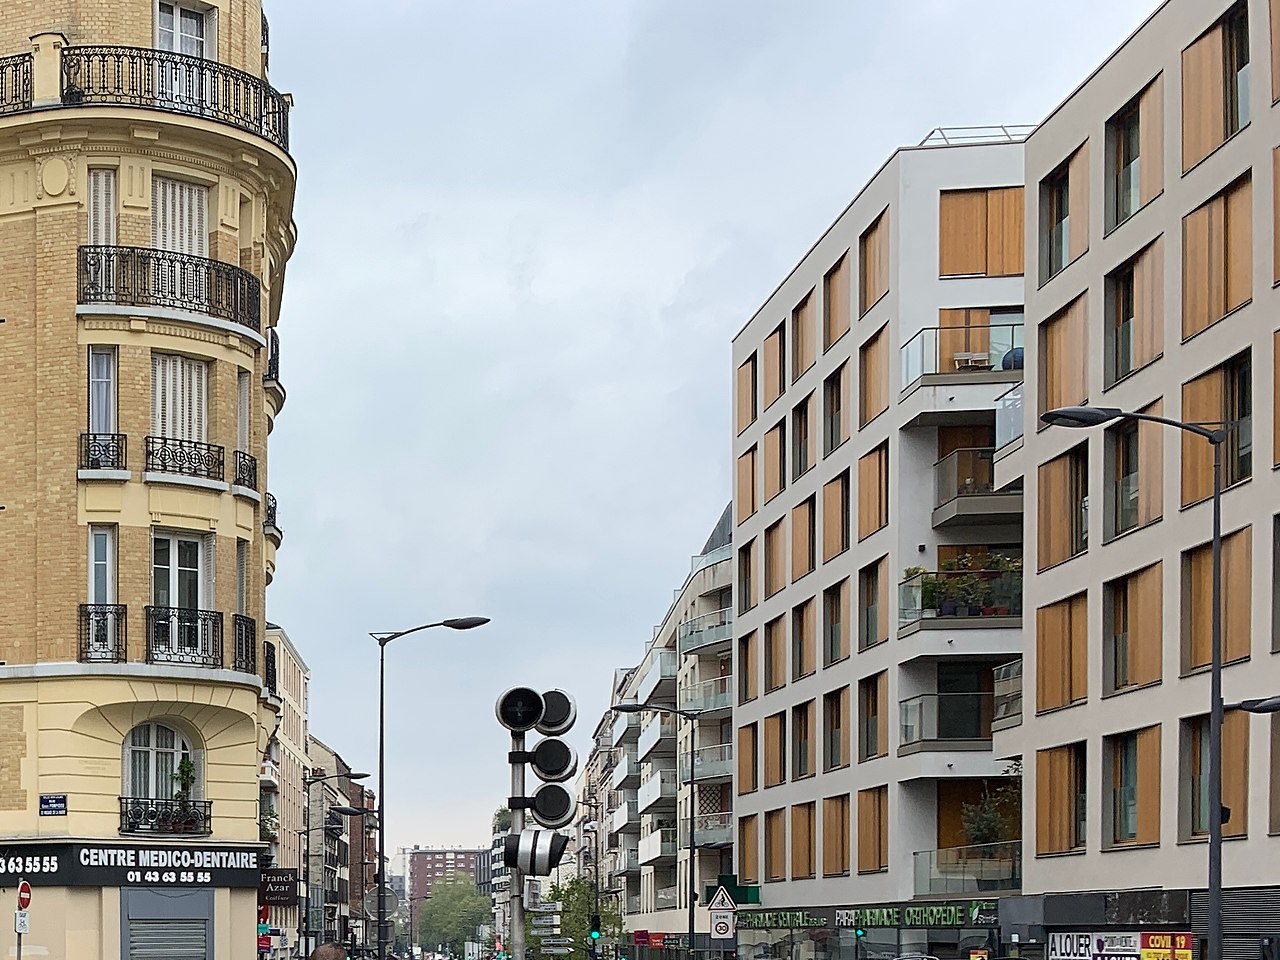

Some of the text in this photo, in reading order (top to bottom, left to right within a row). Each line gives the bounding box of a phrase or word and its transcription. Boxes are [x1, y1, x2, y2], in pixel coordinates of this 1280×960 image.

[7, 856, 23, 873] 63
[24, 856, 41, 873] 55
[42, 856, 58, 873] 55
[79, 848, 258, 869] CENTRE MEDICO-DENTAIRE
[127, 871, 211, 883] 01 43 63 55 55
[261, 873, 294, 882] Franck
[266, 883, 290, 892] Azar
[835, 907, 901, 926] PARAPHARMACIE
[1050, 934, 1091, 957] A LOUER
[1176, 935, 1186, 948] 19
